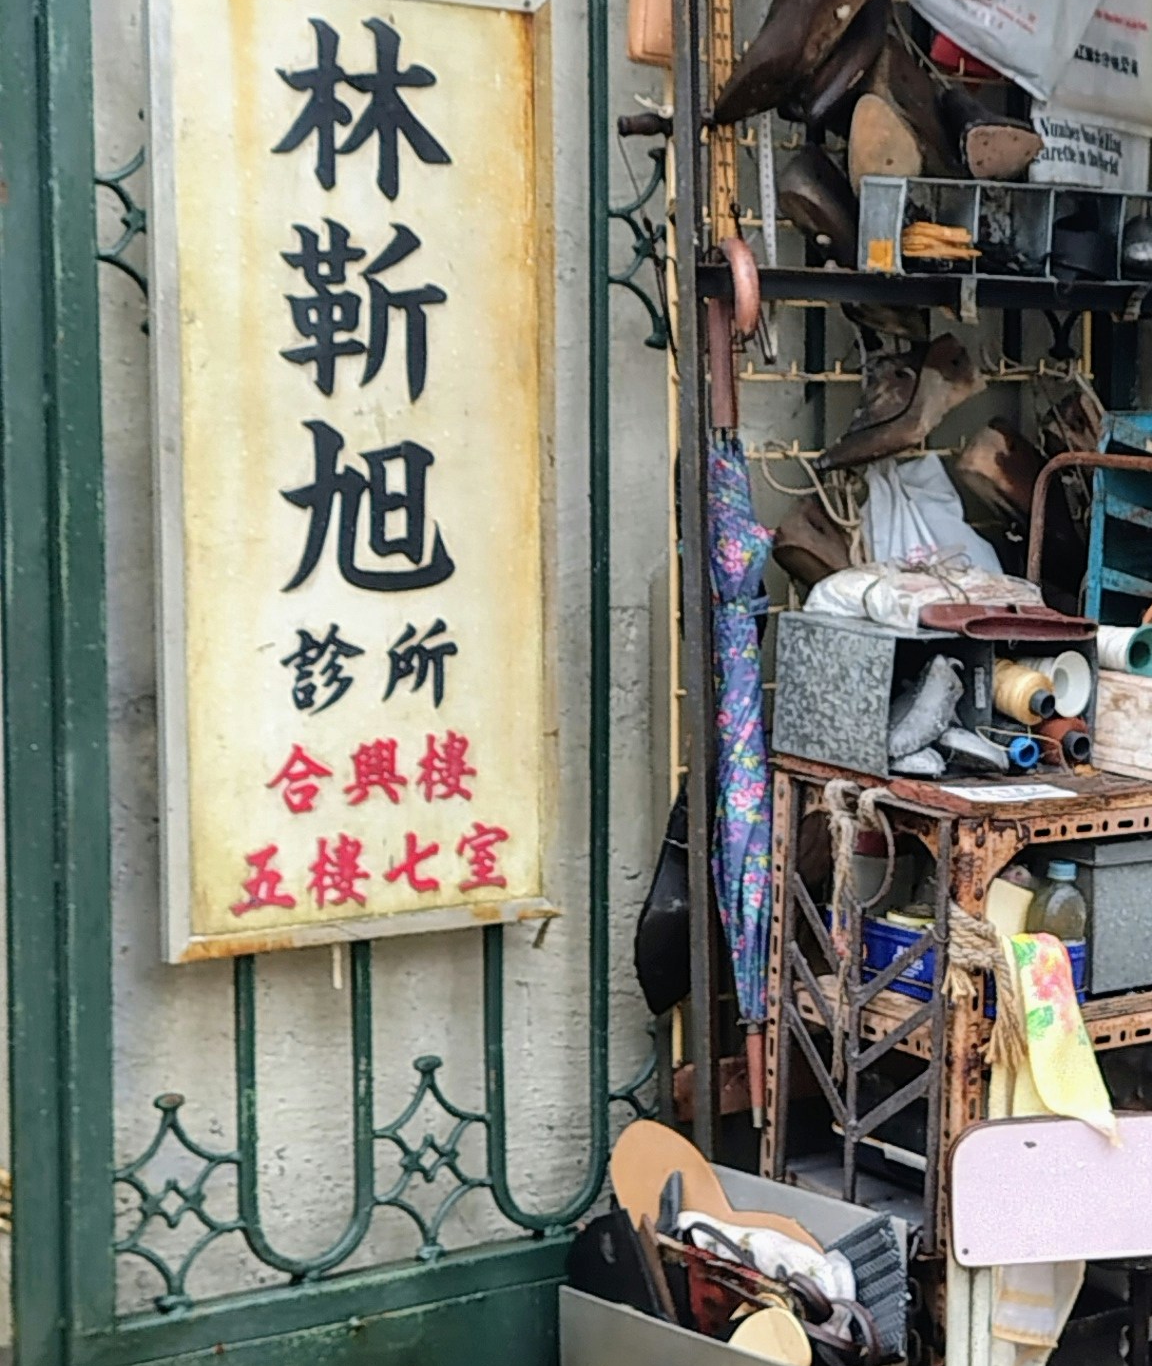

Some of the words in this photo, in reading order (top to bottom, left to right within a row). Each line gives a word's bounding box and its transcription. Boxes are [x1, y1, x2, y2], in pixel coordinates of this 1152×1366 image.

[280, 619, 458, 715] 診所
[265, 729, 479, 814] 合興樓
[230, 821, 511, 918] 五樓七室
